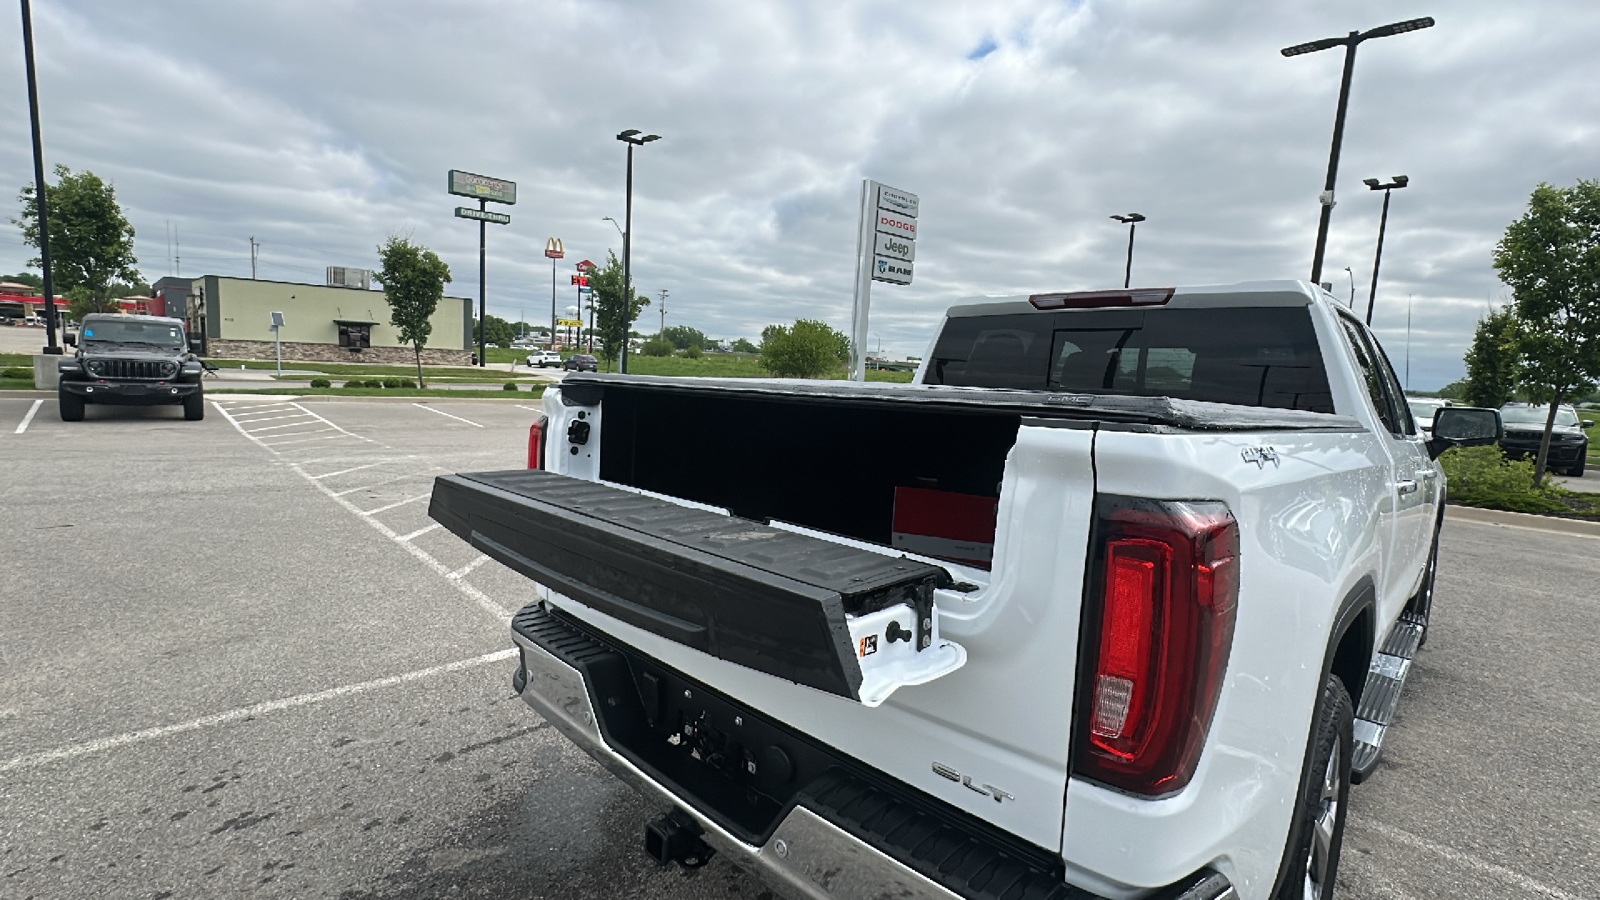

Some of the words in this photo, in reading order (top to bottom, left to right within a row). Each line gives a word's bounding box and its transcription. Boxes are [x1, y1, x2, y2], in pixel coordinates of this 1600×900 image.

[884, 191, 917, 205] CHRYSLER
[461, 208, 509, 222] DRIVE-THRU
[880, 217, 915, 232] DODGE
[884, 238, 909, 257] Jeep
[888, 265, 912, 276] RAM
[1047, 395, 1090, 403] GMC
[932, 761, 1015, 803] SLT
